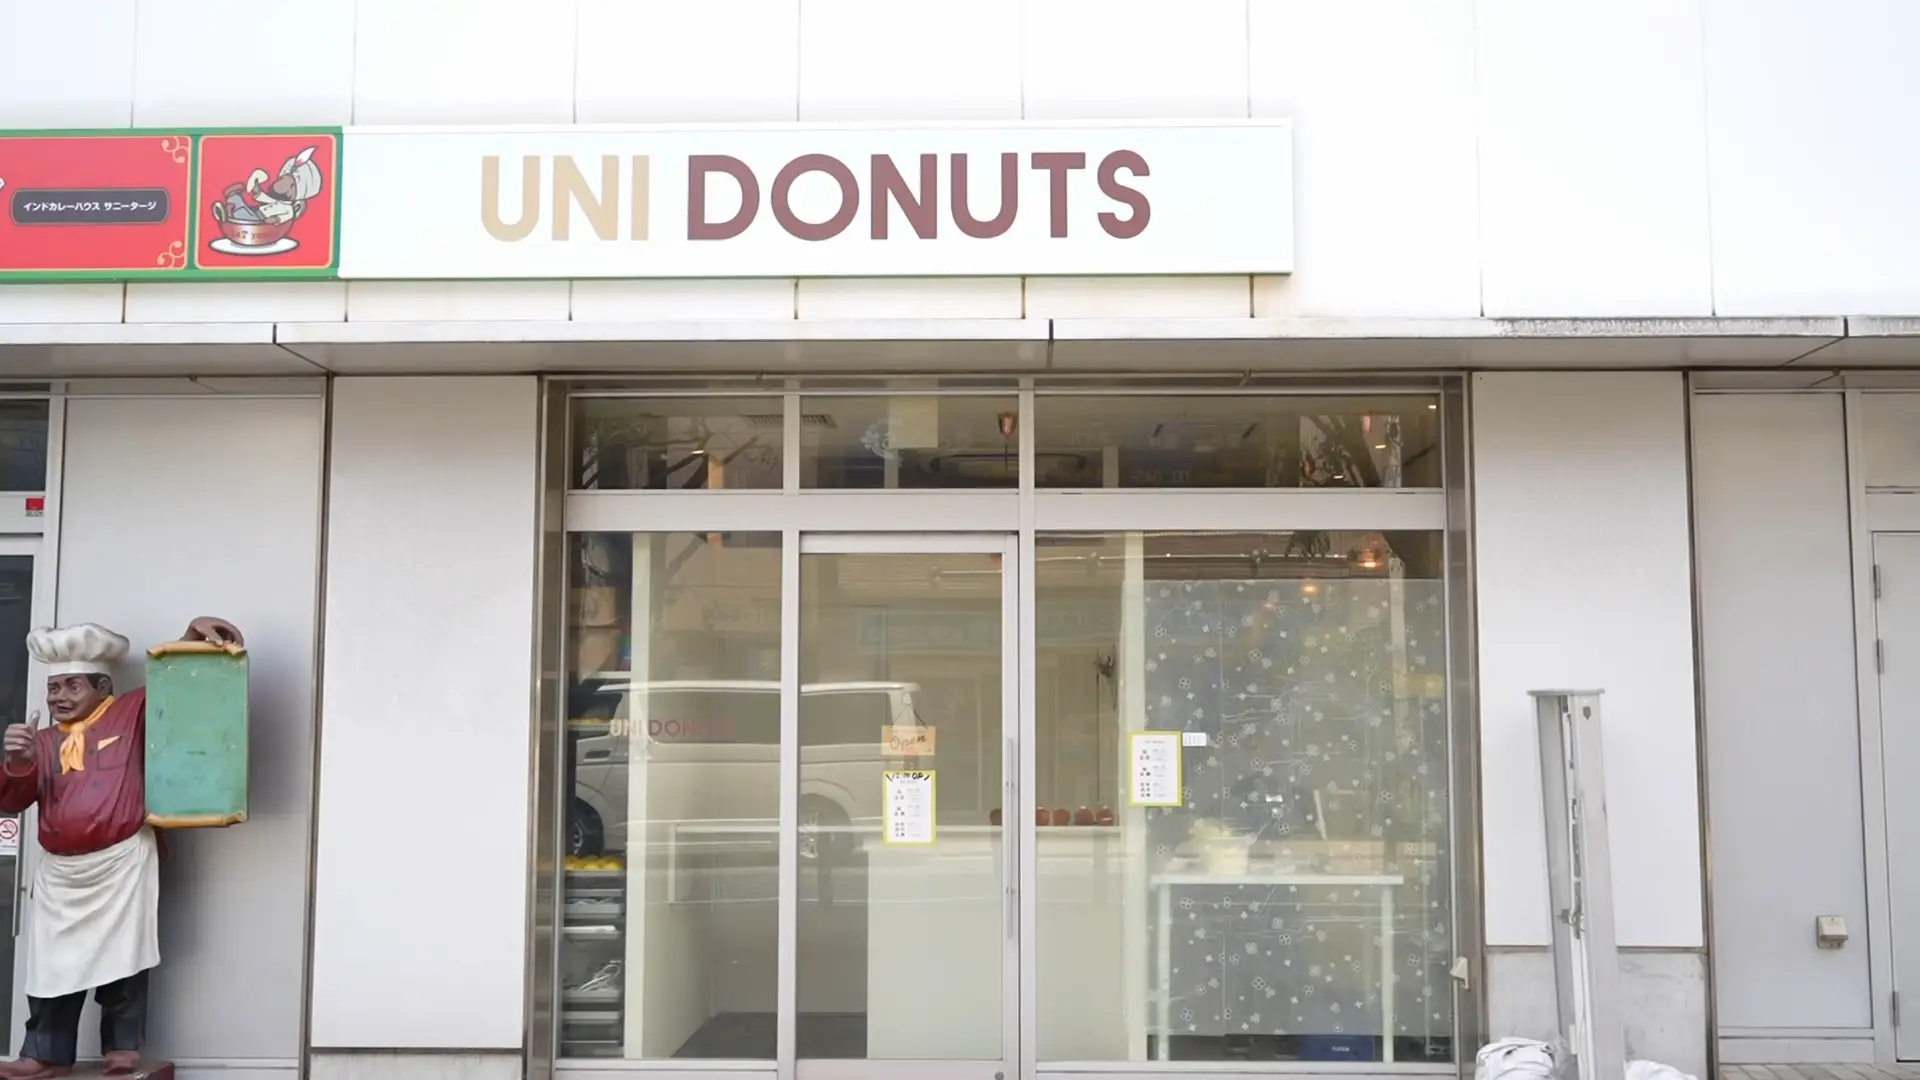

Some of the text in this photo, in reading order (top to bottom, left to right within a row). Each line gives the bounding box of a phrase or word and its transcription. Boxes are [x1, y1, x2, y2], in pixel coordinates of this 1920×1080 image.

[23, 200, 158, 212] インドカレーハウス サニータージ
[481, 150, 1152, 242] UNI DONUTS
